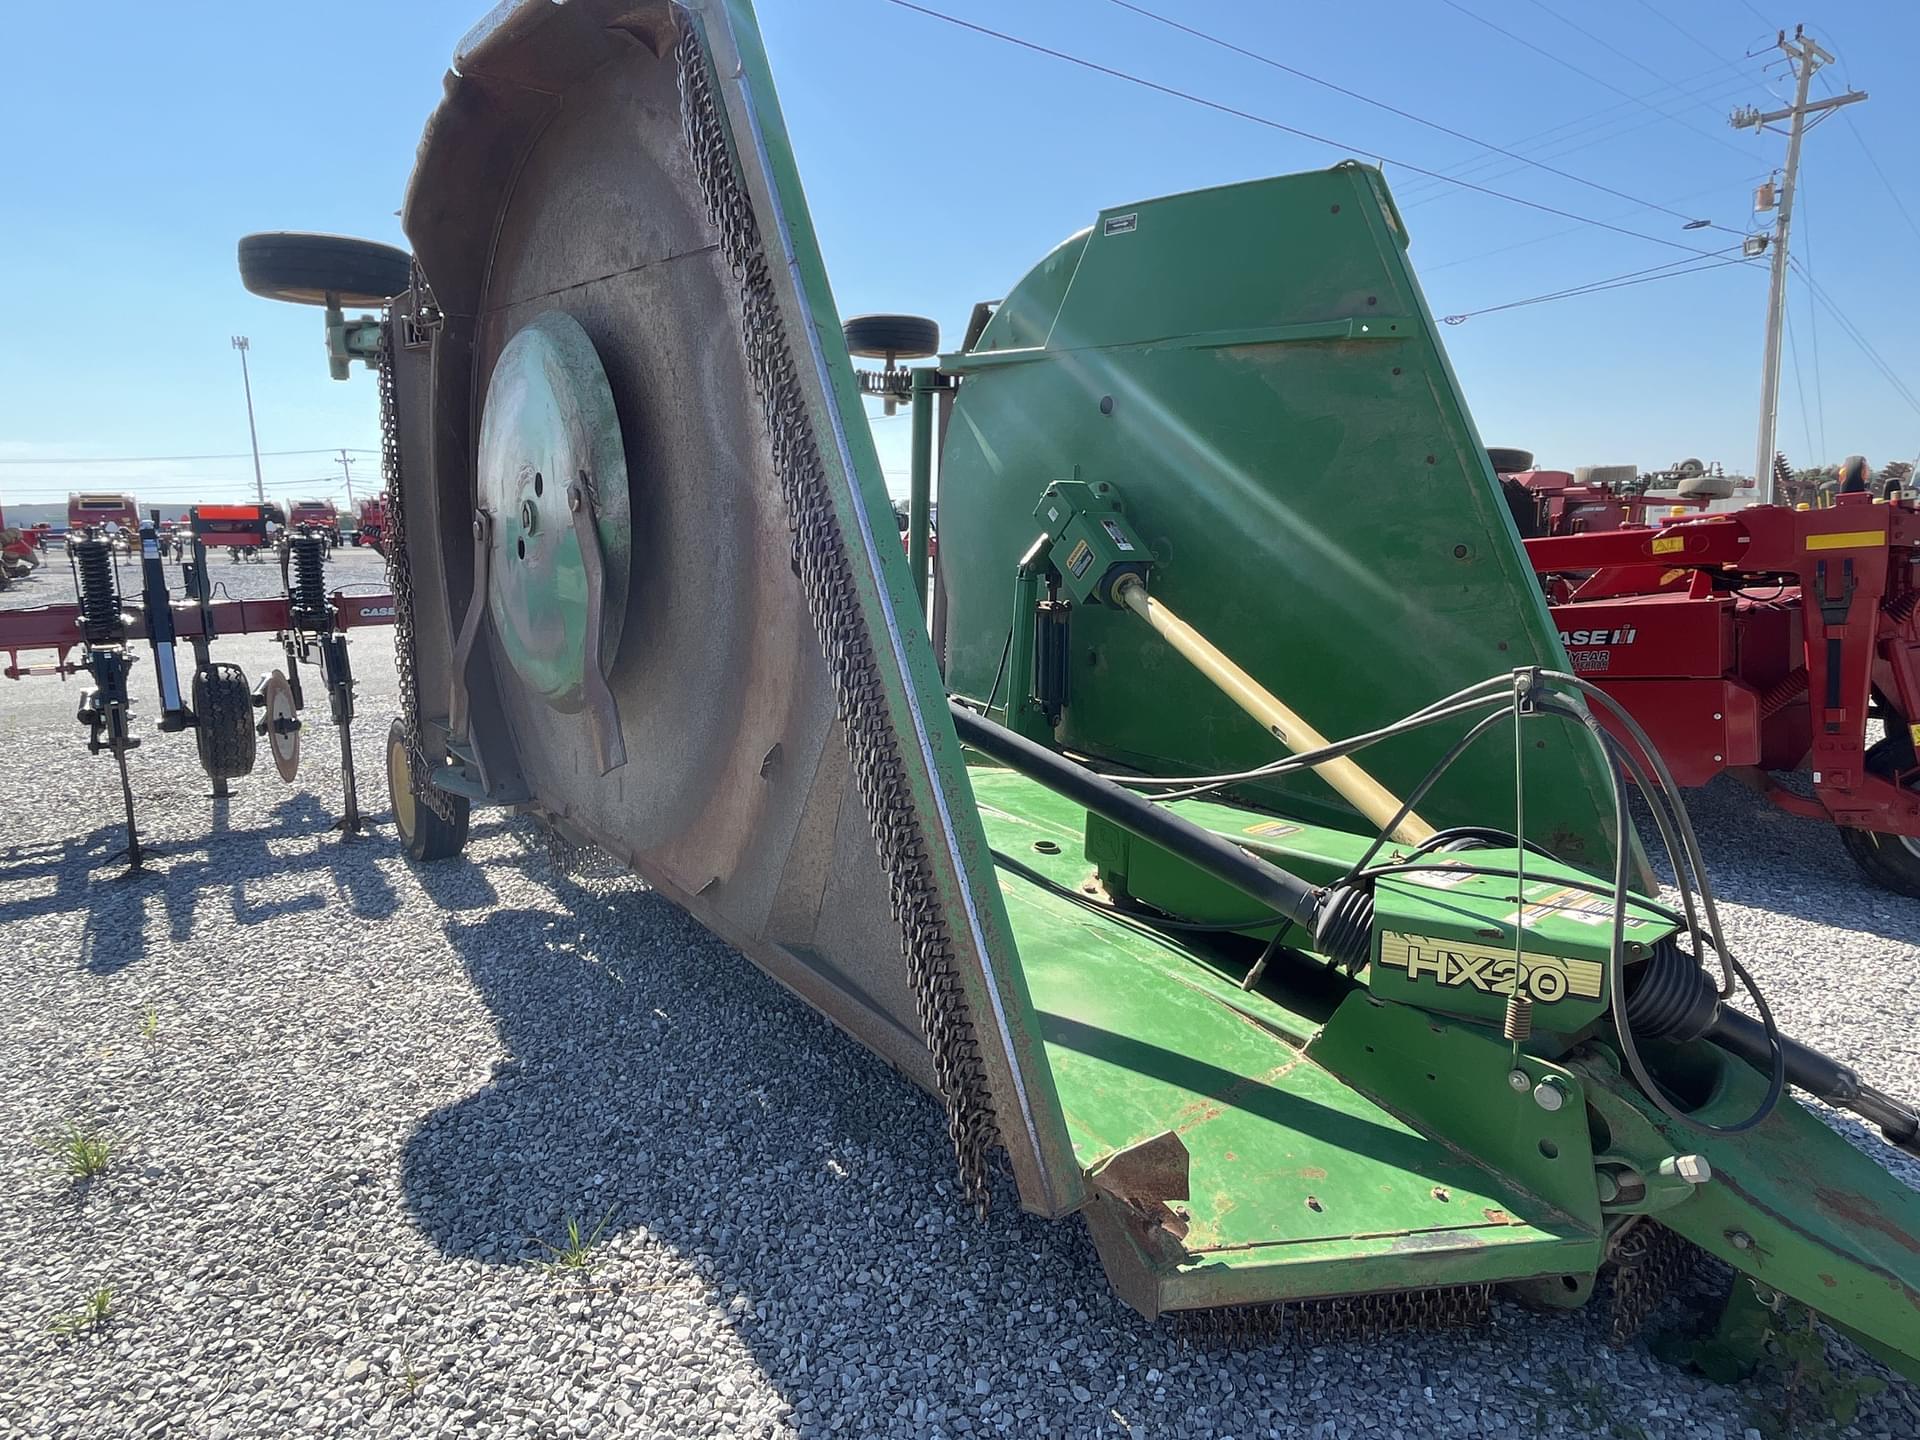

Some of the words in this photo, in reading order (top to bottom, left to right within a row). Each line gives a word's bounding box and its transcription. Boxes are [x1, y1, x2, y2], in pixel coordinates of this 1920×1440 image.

[360, 607, 396, 617] CASE
[1559, 630, 1609, 646] ASE
[1571, 650, 1610, 662] YEAR
[1407, 945, 1568, 1003] HX20
